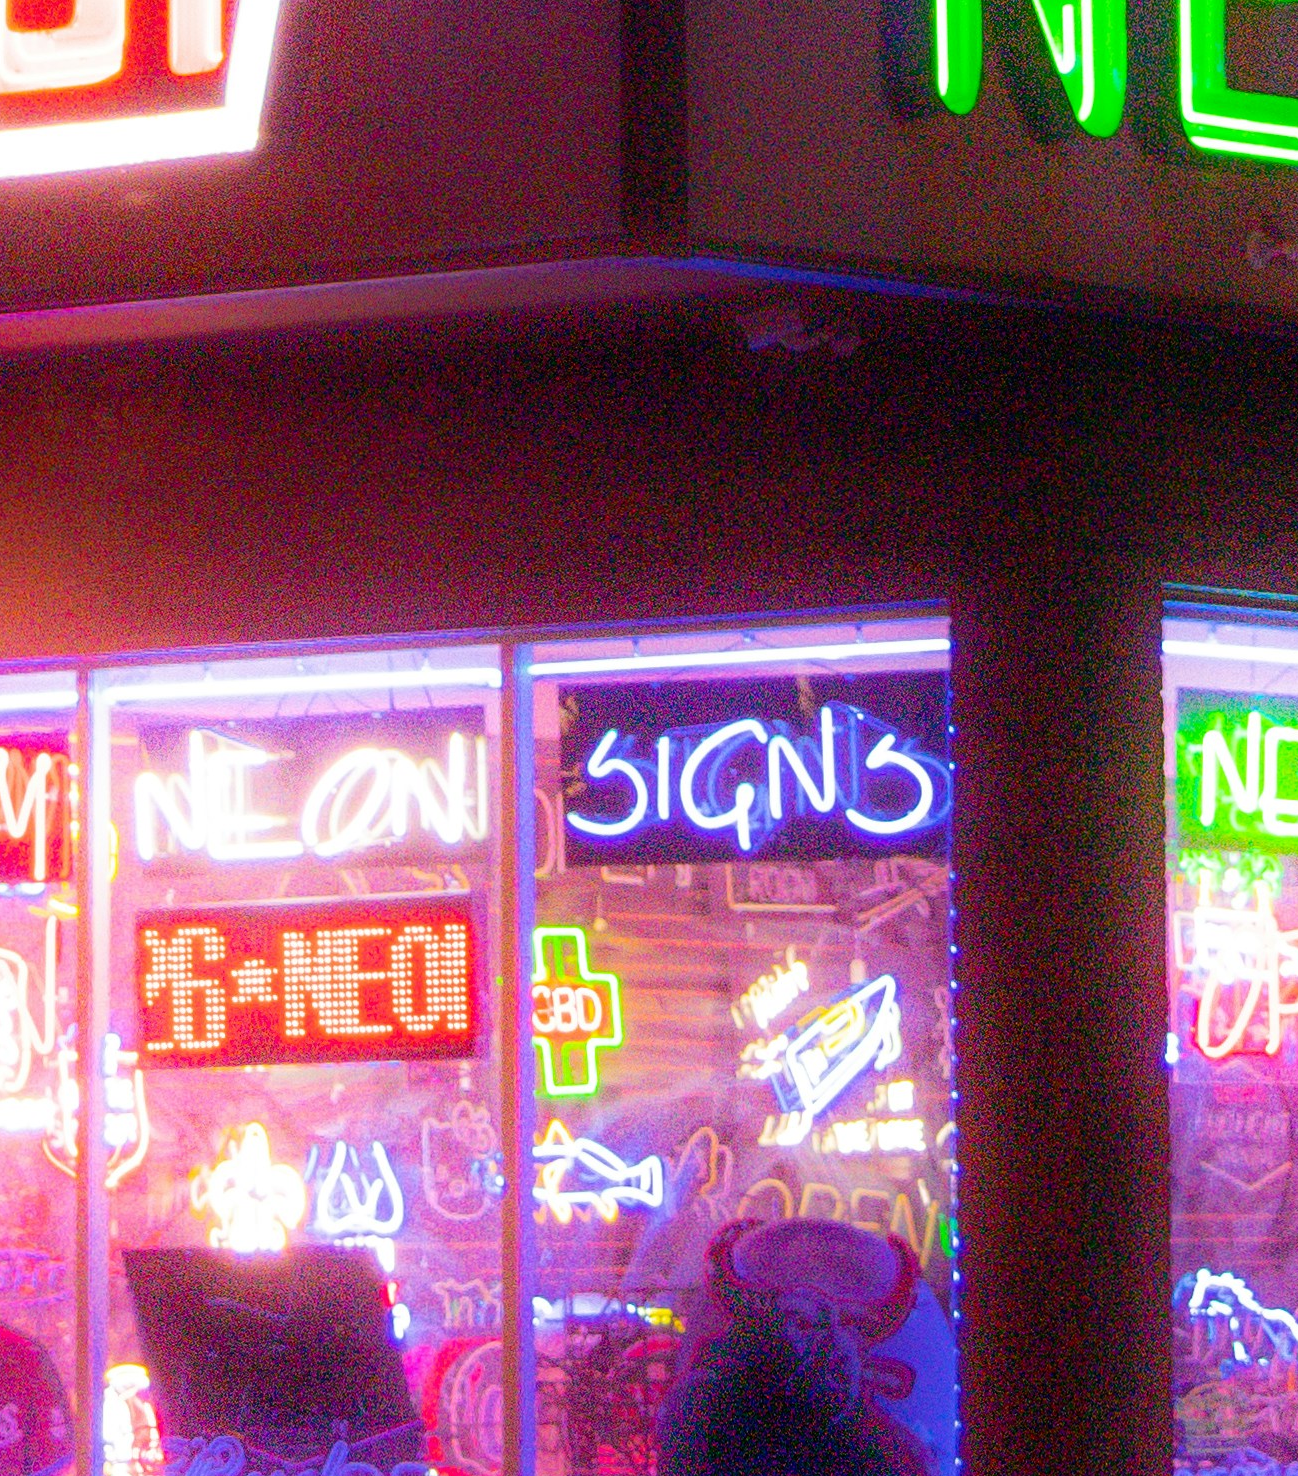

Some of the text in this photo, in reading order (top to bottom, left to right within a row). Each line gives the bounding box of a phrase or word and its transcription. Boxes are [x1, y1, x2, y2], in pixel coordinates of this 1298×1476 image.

[133, 728, 467, 866] NEON
[566, 704, 935, 850] SIGNS
[532, 984, 602, 1033] CBD
